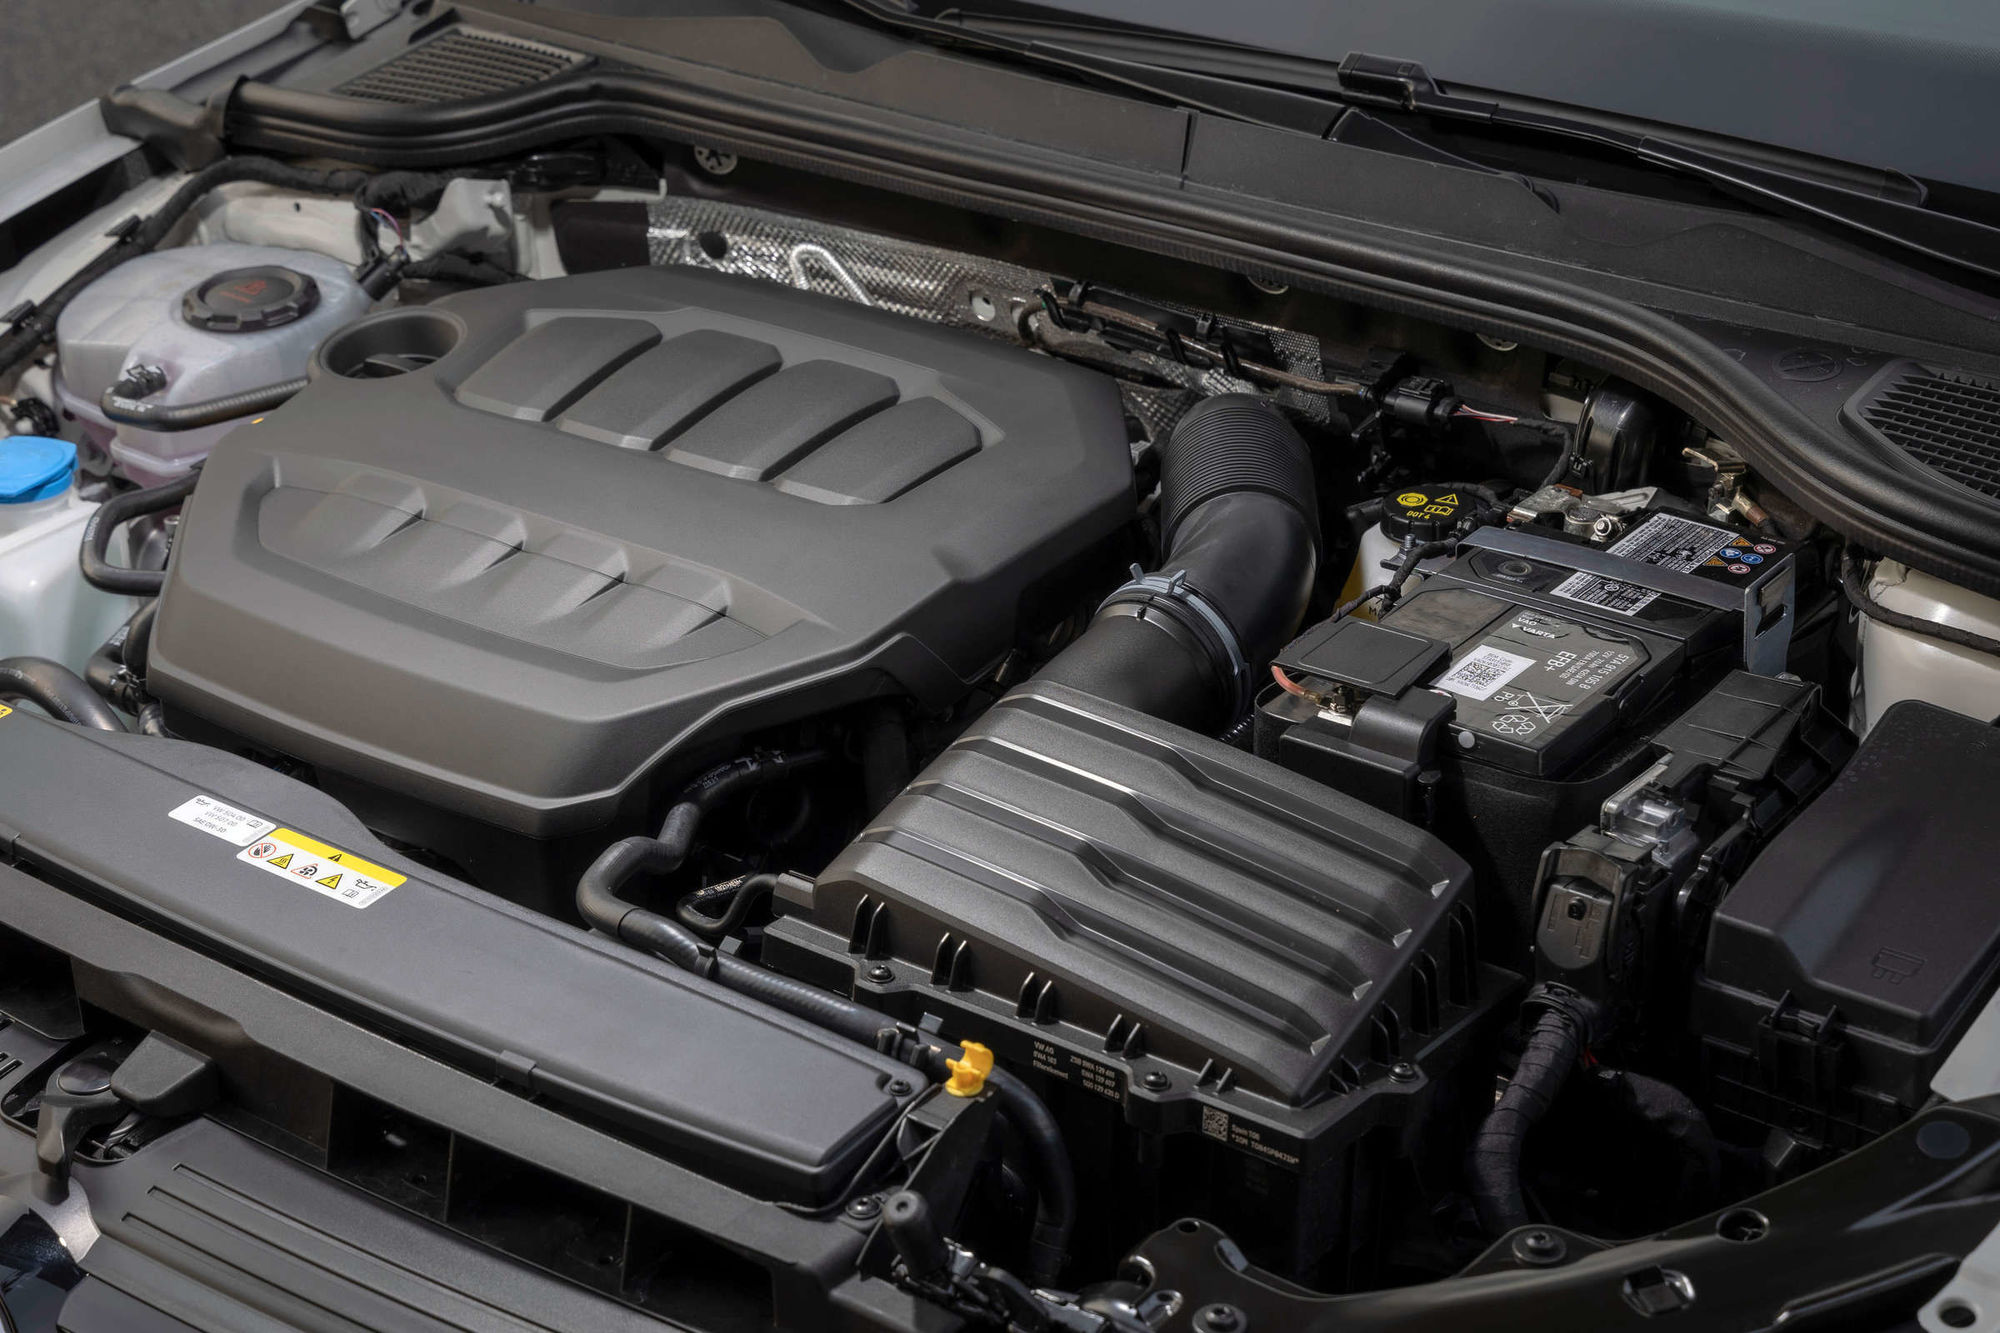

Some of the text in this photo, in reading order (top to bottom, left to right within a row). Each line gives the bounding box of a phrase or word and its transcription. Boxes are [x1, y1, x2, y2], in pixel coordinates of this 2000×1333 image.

[1406, 510, 1424, 518] DOT
[1523, 626, 1555, 639] VARTA
[1543, 650, 1577, 671] EFB+
[1598, 663, 1617, 675] 915
[1494, 690, 1515, 702] Pb
